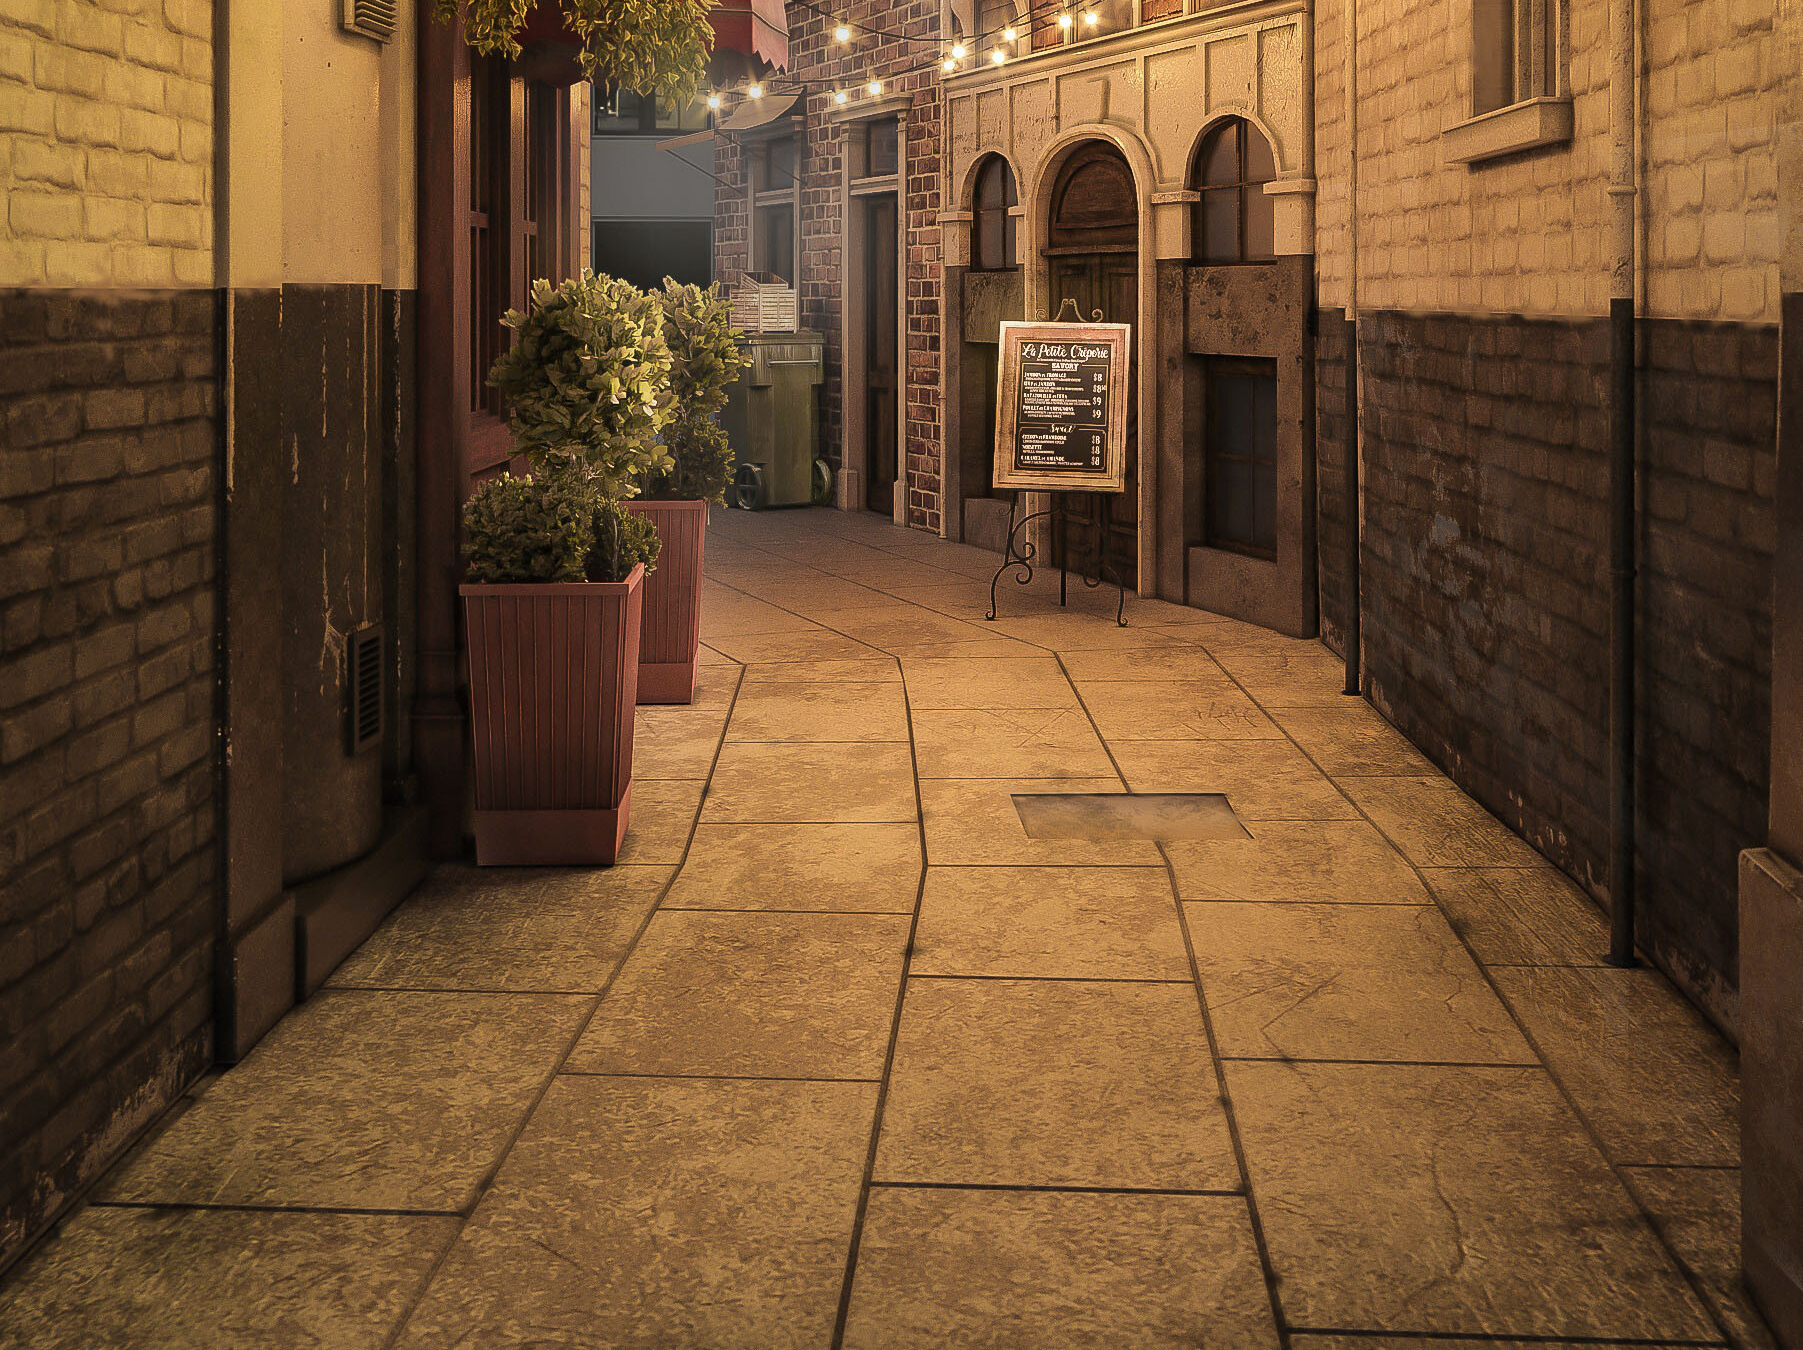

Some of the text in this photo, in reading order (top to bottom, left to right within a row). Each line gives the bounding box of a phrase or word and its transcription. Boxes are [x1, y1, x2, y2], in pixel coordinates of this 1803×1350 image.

[1022, 344, 1036, 358] La
[1038, 344, 1067, 358] Petite
[1092, 396, 1102, 406] $9
[1092, 409, 1102, 419] $9
